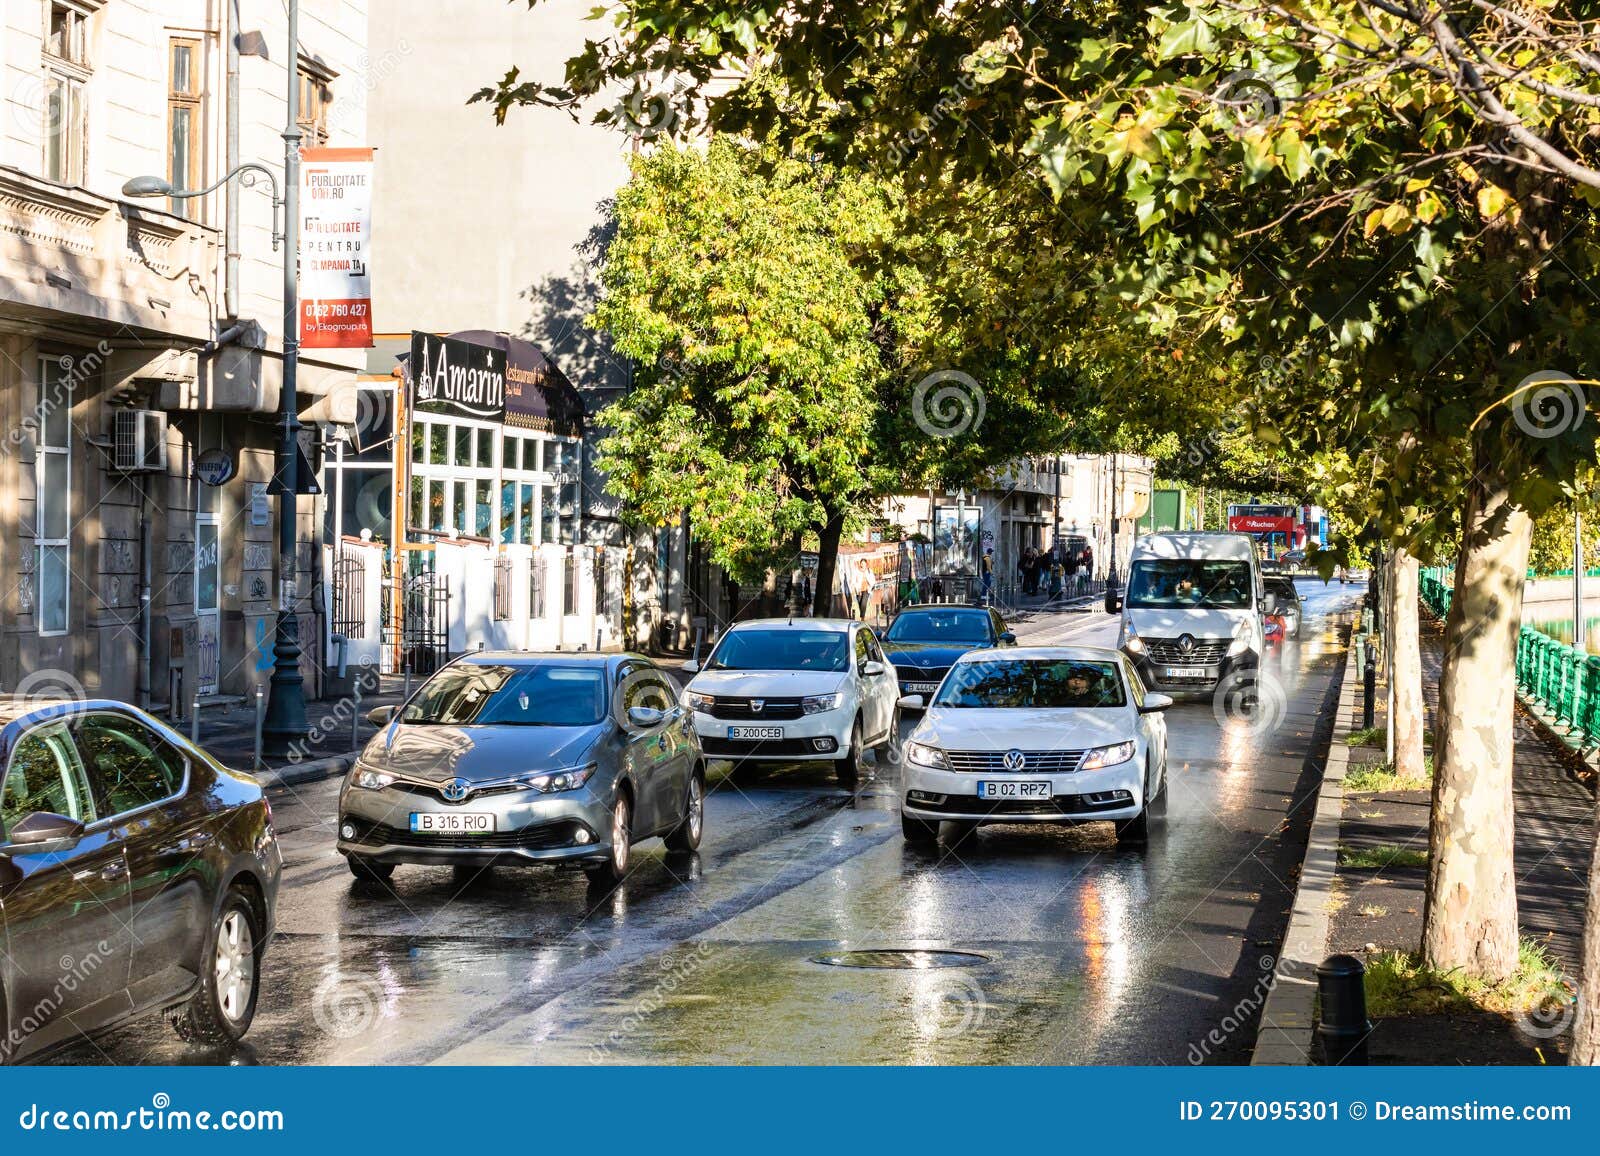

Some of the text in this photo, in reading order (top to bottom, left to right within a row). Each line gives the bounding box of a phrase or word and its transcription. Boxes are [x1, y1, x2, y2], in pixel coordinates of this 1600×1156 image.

[311, 175, 366, 187] PUBLICITATE
[309, 241, 361, 251] PENTRU
[352, 259, 361, 270] TA
[330, 304, 348, 317] 760
[350, 303, 367, 316] 427
[305, 322, 316, 333] by
[433, 343, 504, 408] Amarin
[1250, 520, 1275, 528] Auchan
[733, 728, 740, 738] B
[988, 783, 1047, 796] B 02 RPZ
[423, 815, 487, 829] B 316 RIO
